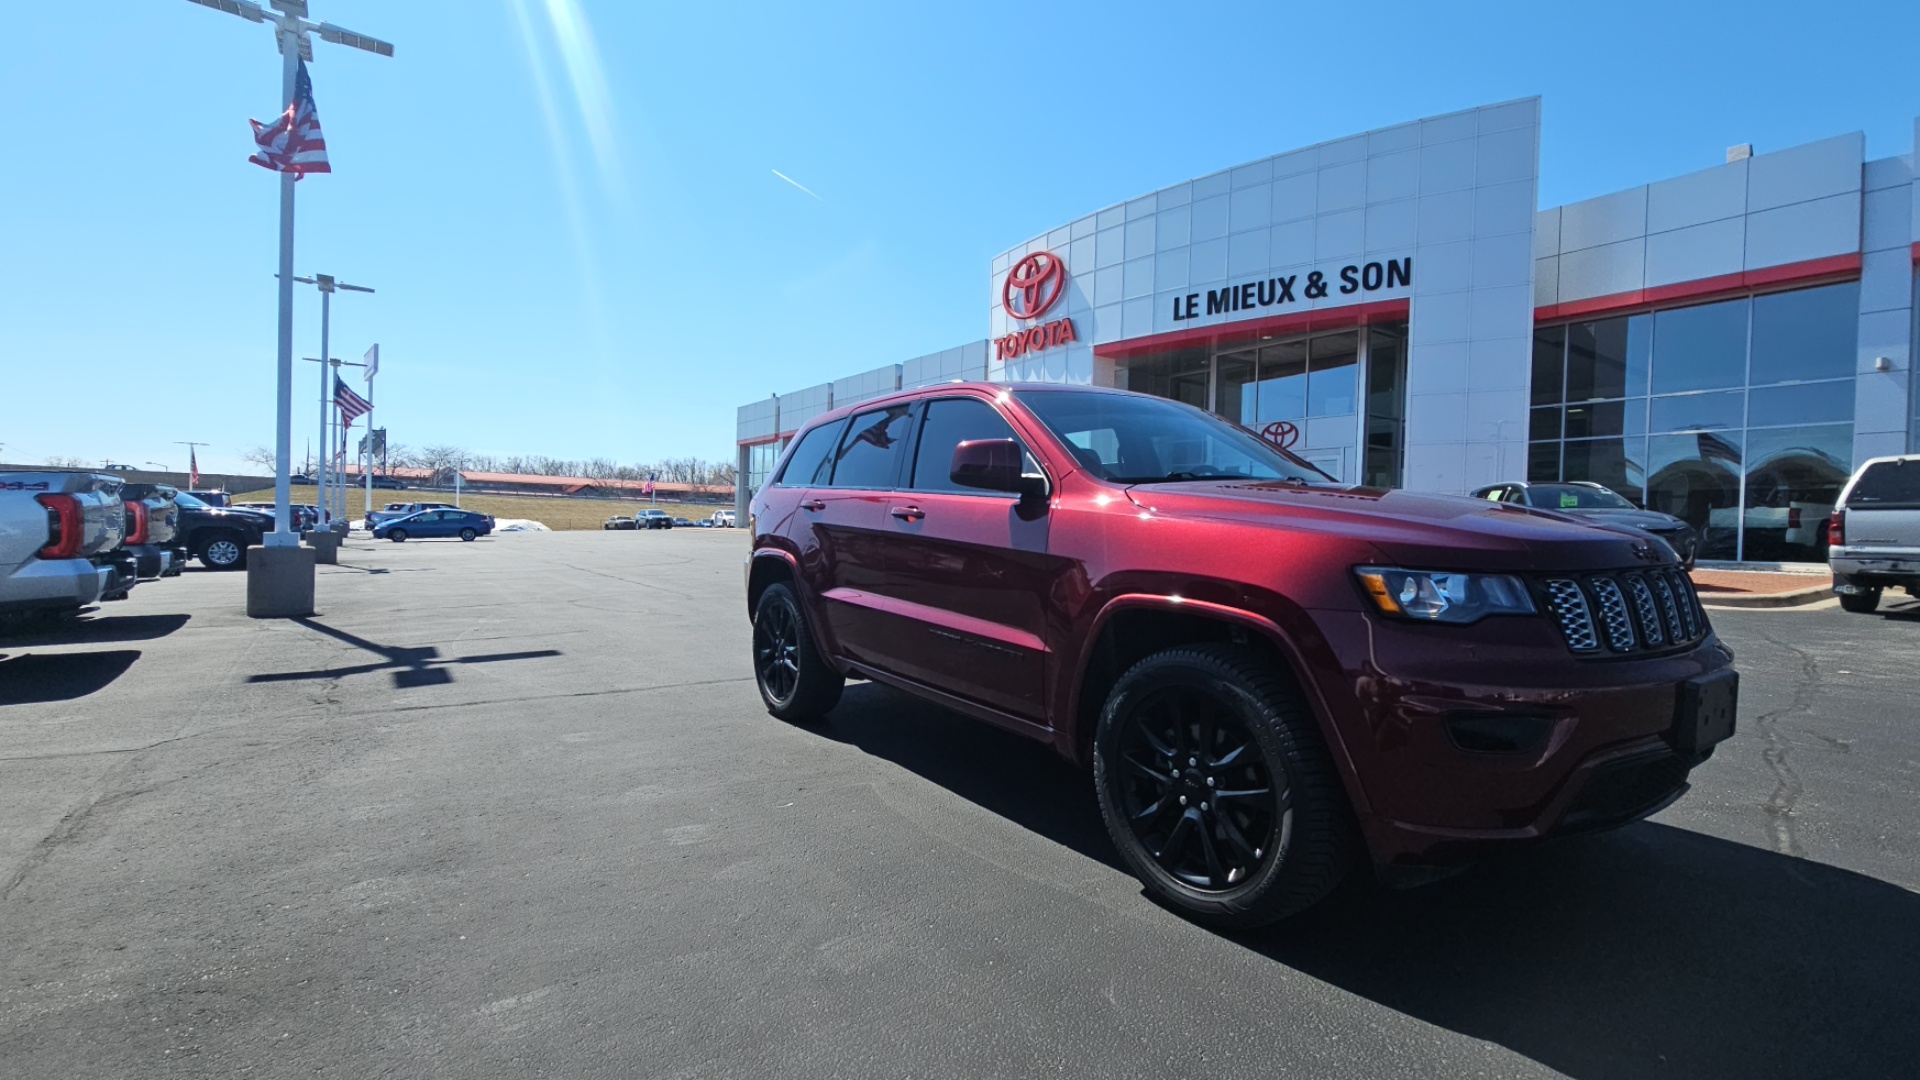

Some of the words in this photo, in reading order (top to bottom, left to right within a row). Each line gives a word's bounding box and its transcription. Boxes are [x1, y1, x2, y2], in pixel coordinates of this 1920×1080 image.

[1173, 293, 1199, 321] LE
[1206, 275, 1297, 315] MIEUX
[1304, 271, 1328, 299] &
[1340, 257, 1411, 294] SON
[994, 317, 1076, 361] TOYOTA
